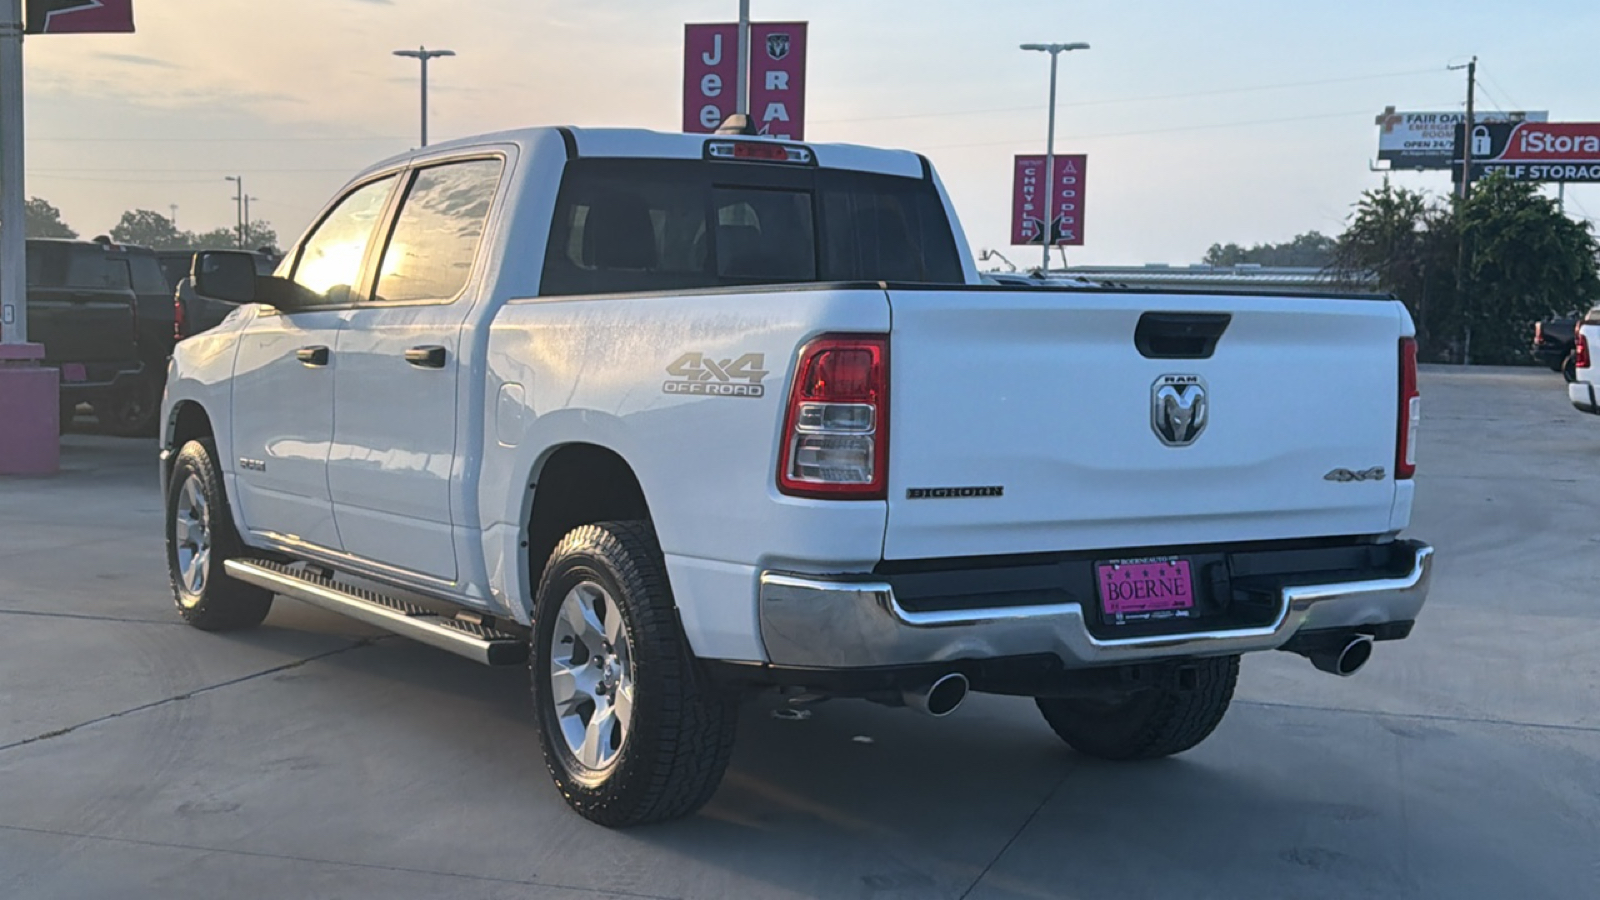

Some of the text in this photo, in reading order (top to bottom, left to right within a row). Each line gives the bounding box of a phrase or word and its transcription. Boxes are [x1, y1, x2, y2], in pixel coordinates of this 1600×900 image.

[762, 70, 791, 140] RA
[1406, 114, 1437, 124] FAIR
[1403, 140, 1431, 148] OPEN
[1520, 130, 1600, 153] iStora
[1164, 376, 1198, 384] RAM
[664, 382, 762, 396] OFF ROAD
[1107, 578, 1187, 601] BOERNE
